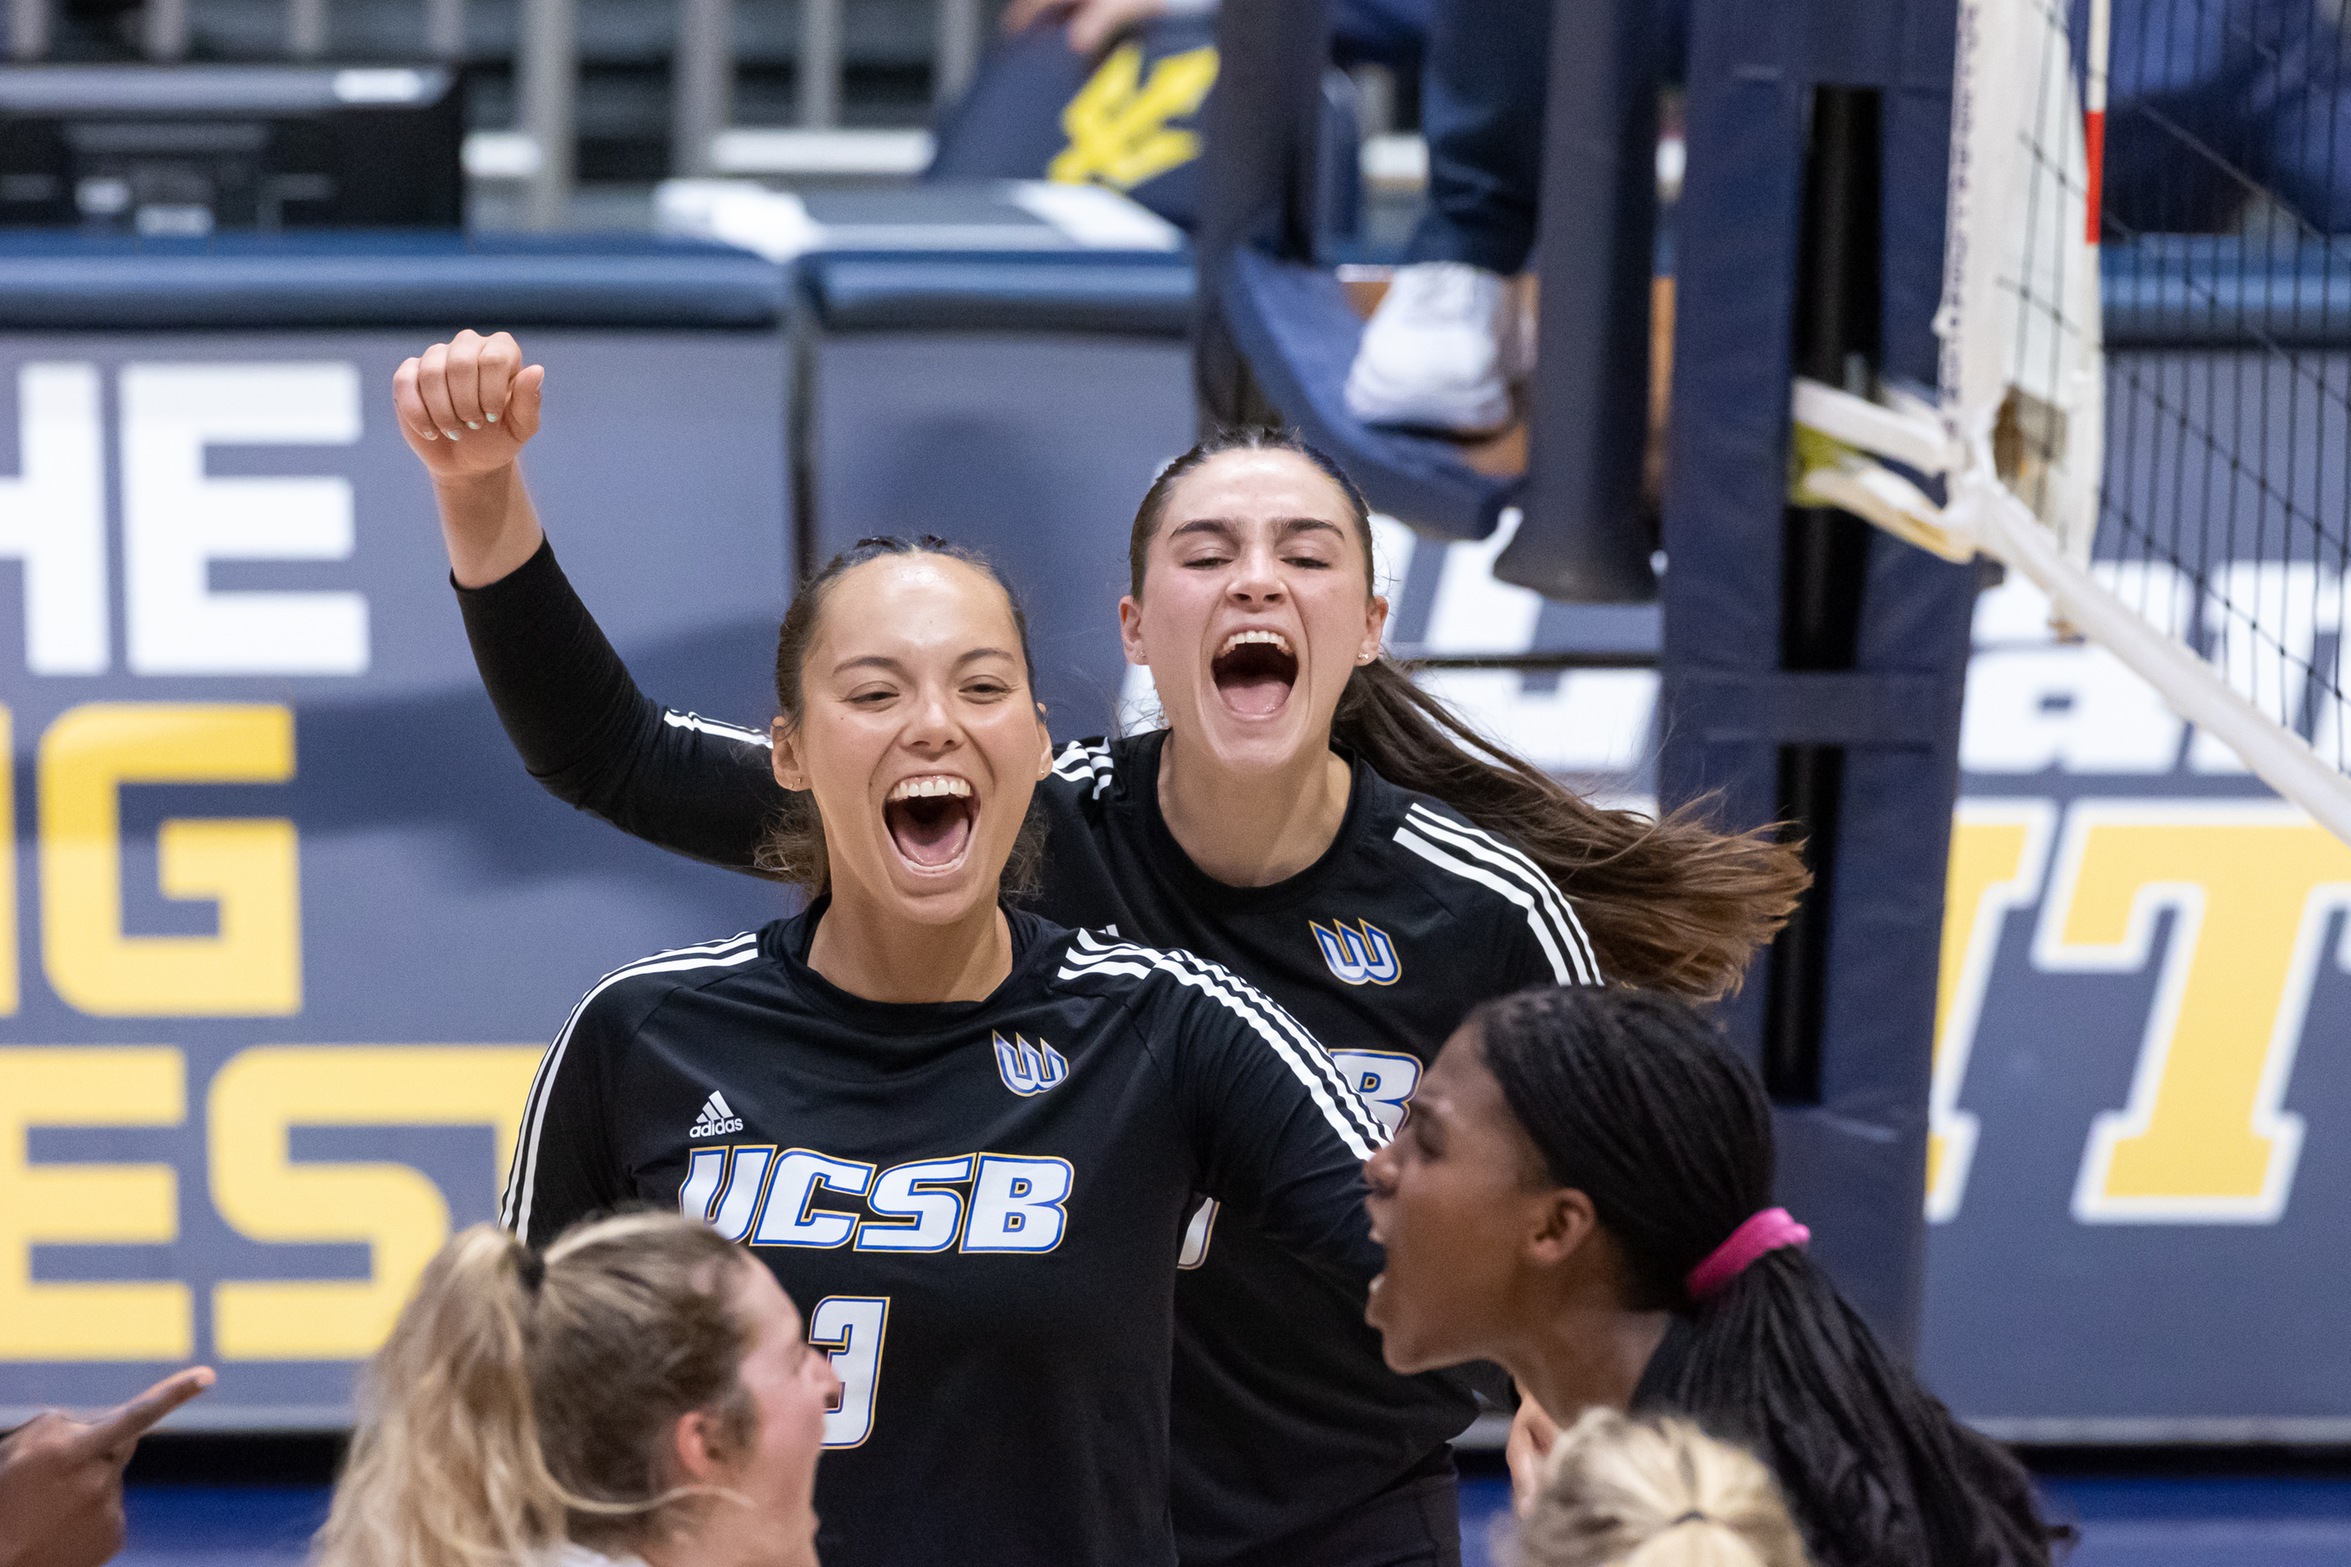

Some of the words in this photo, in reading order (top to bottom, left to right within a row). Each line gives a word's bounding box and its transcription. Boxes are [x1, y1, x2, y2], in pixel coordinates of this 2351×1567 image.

[0, 702, 303, 1018] G
[689, 1118, 744, 1138] adidas
[679, 1144, 1075, 1255] UCSB
